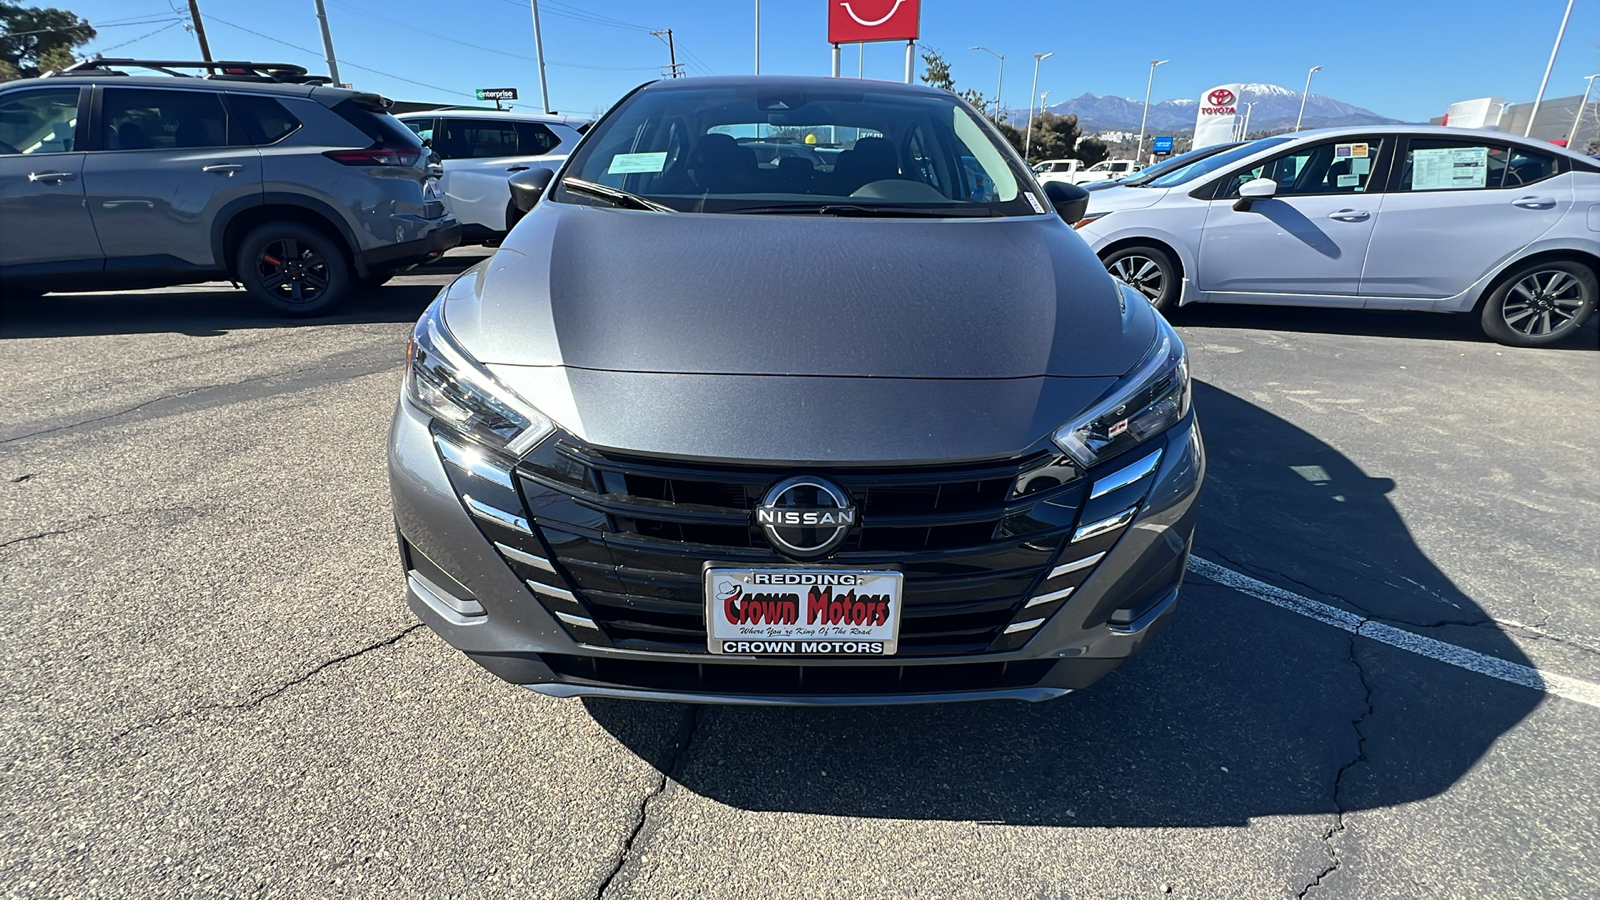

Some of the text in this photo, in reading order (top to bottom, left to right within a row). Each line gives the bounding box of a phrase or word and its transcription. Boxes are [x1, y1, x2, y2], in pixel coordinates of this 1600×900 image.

[477, 90, 513, 98] enterprise
[1201, 107, 1236, 115] TOYOTA
[759, 510, 853, 525] NISSAN
[755, 574, 855, 585] REDDING
[723, 585, 890, 627] Crown Motors
[740, 627, 872, 637] Where You're King Of The Road
[723, 641, 883, 653] CROWN MOTORS
